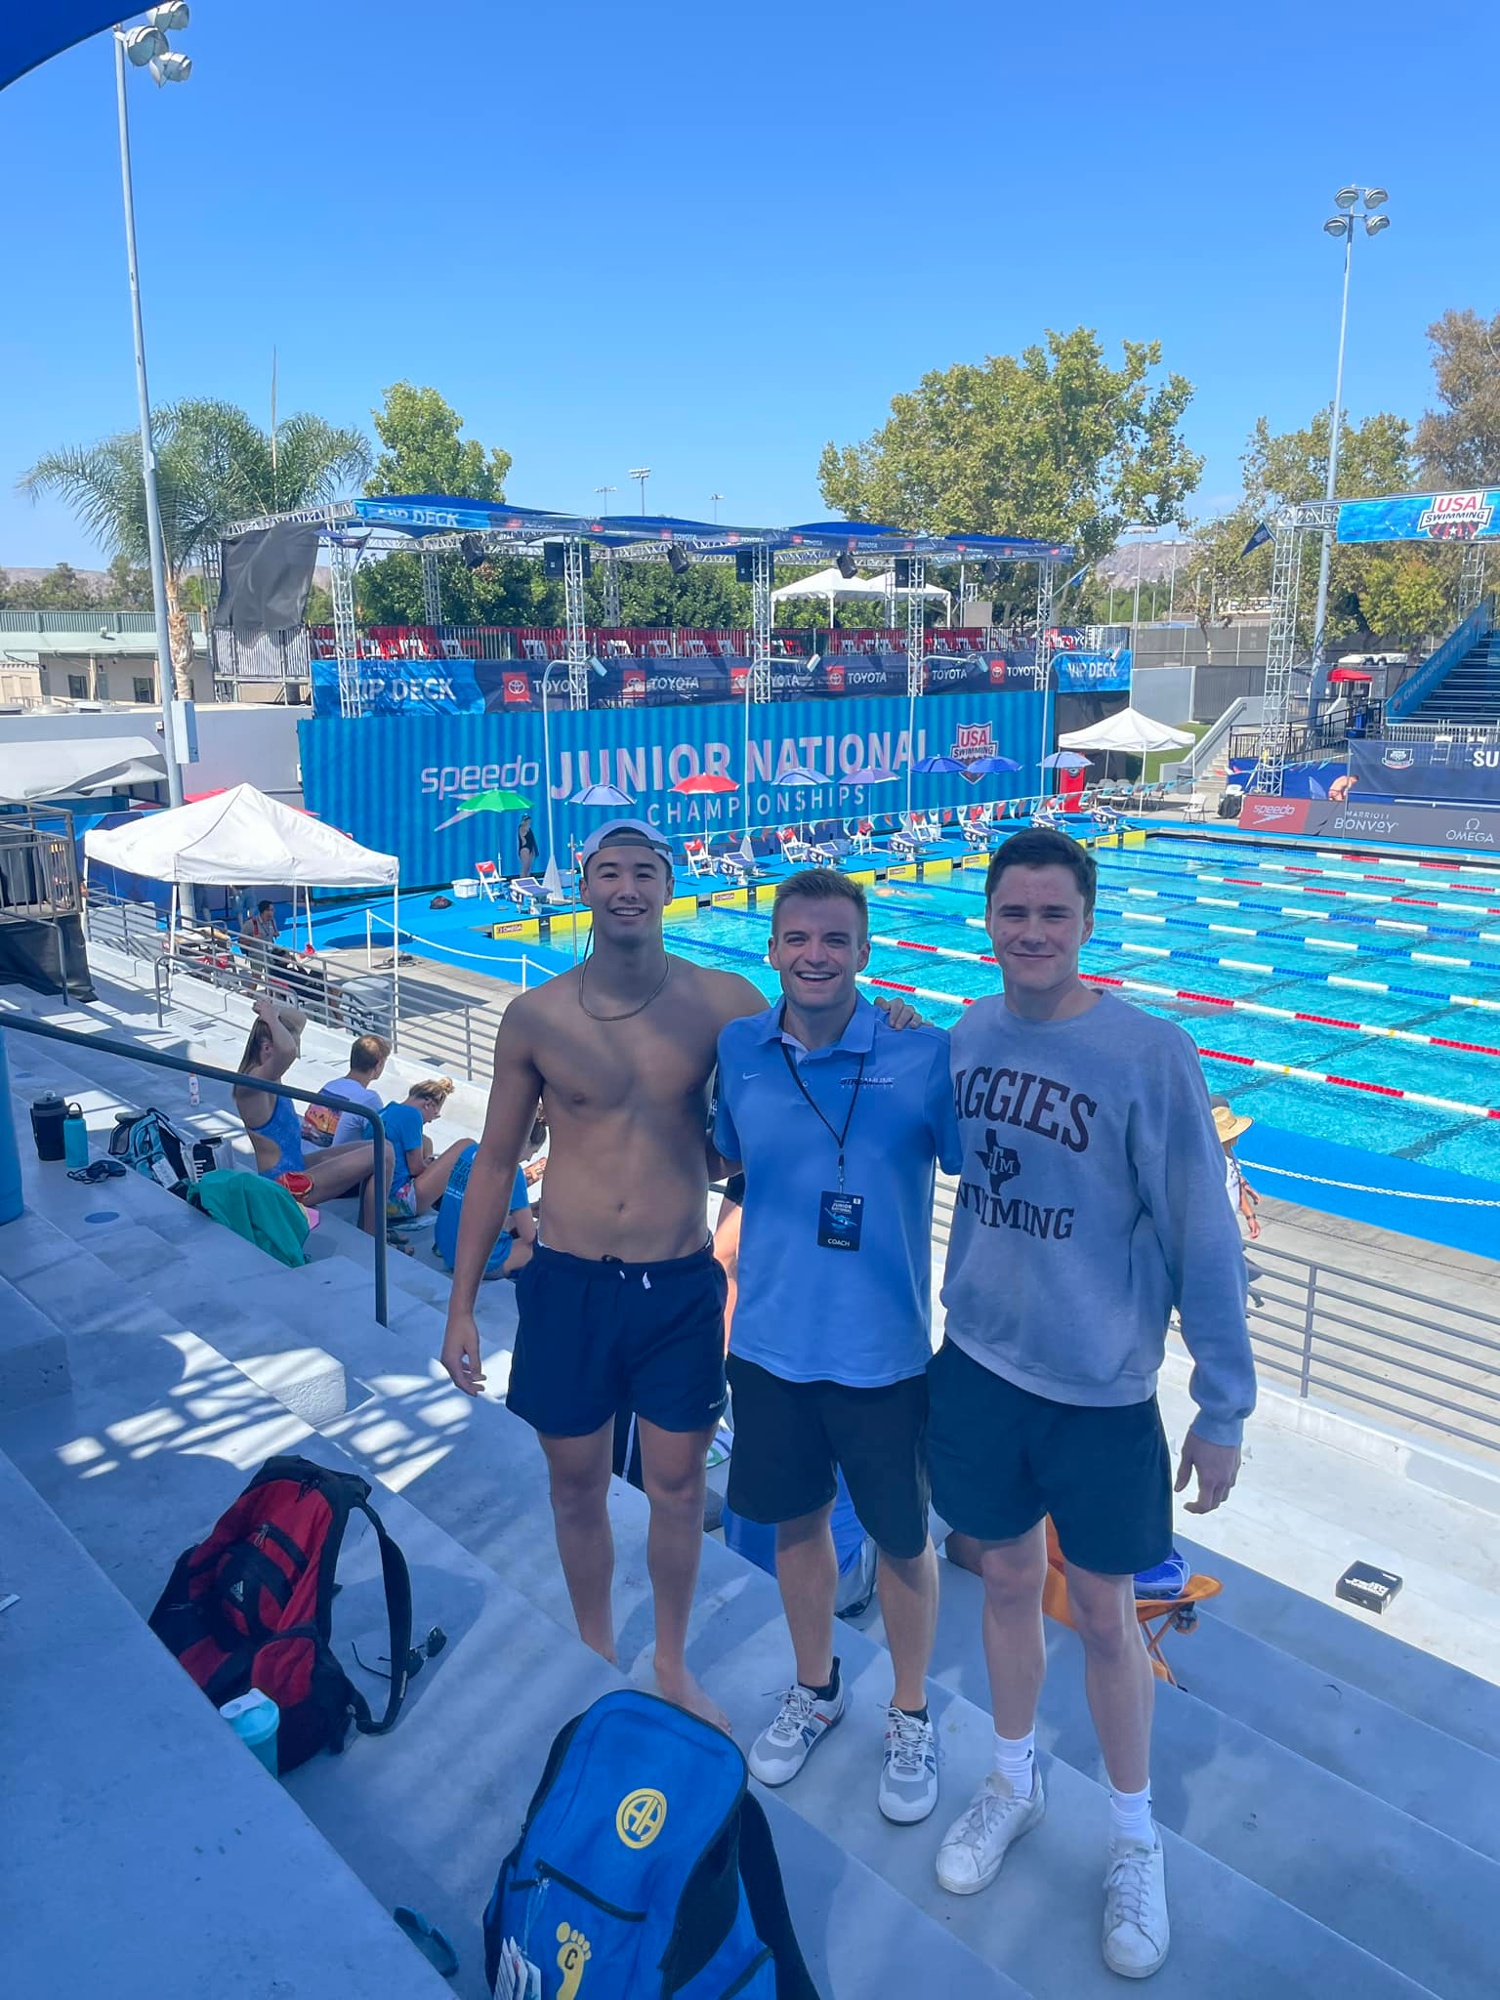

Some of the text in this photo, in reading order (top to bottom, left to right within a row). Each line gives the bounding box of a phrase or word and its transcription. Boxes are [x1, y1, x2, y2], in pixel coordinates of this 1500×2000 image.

[1437, 496, 1477, 513] USA
[412, 509, 459, 527] DECK
[1425, 511, 1485, 523] SWIMMING
[847, 672, 887, 684] TOYOTA
[932, 668, 967, 680] TOYOTA
[1089, 661, 1117, 678] DECK
[392, 677, 456, 700] DECK
[960, 730, 988, 747] USA
[953, 745, 994, 759] SWIMMING
[421, 754, 540, 801] speedo
[550, 742, 731, 800] JUNIOR
[647, 785, 865, 827] CHAMPIONSHIPS
[1253, 804, 1296, 816] speedo
[1334, 817, 1397, 834] BONVOY
[1446, 829, 1494, 844] OMEGA
[954, 1066, 1098, 1153] AGGIES
[827, 1238, 850, 1246] COACH
